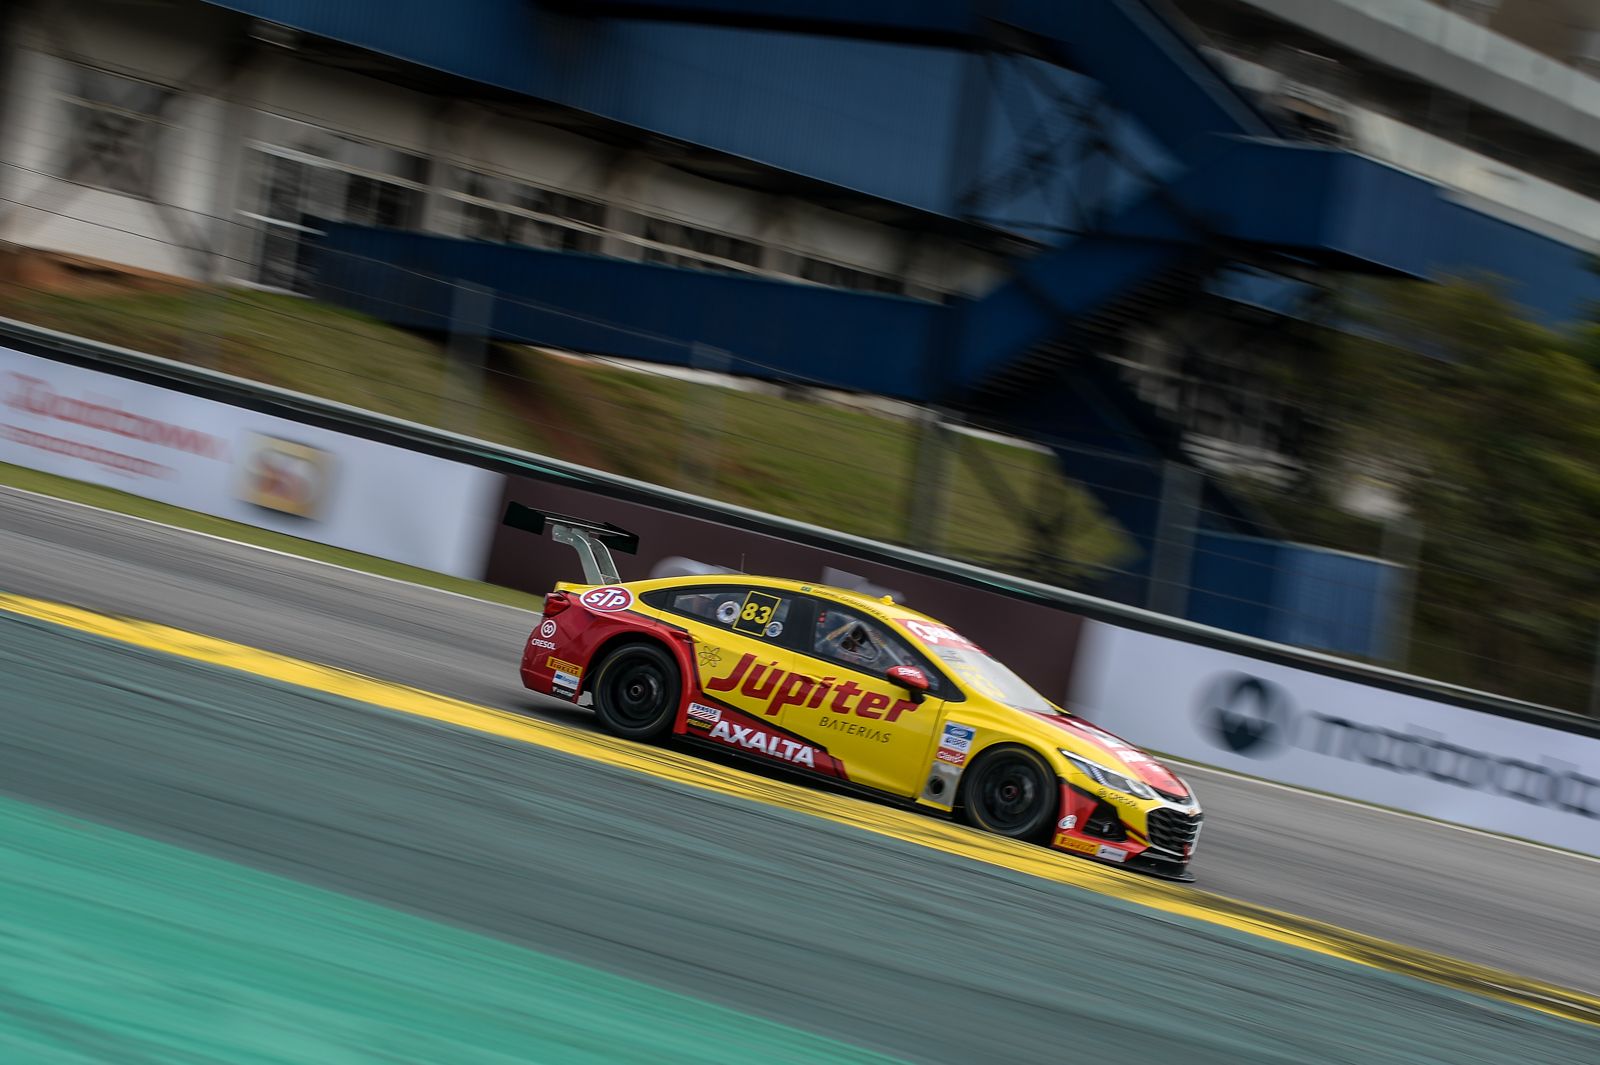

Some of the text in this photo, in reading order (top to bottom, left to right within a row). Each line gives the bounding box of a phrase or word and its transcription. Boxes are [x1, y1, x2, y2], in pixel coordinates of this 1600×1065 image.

[585, 589, 626, 608] STP
[741, 602, 772, 624] 83
[531, 638, 556, 650] CRESOL
[705, 652, 921, 723] Júpiter
[819, 716, 892, 744] BATERIAS
[708, 719, 815, 769] AXALTA
